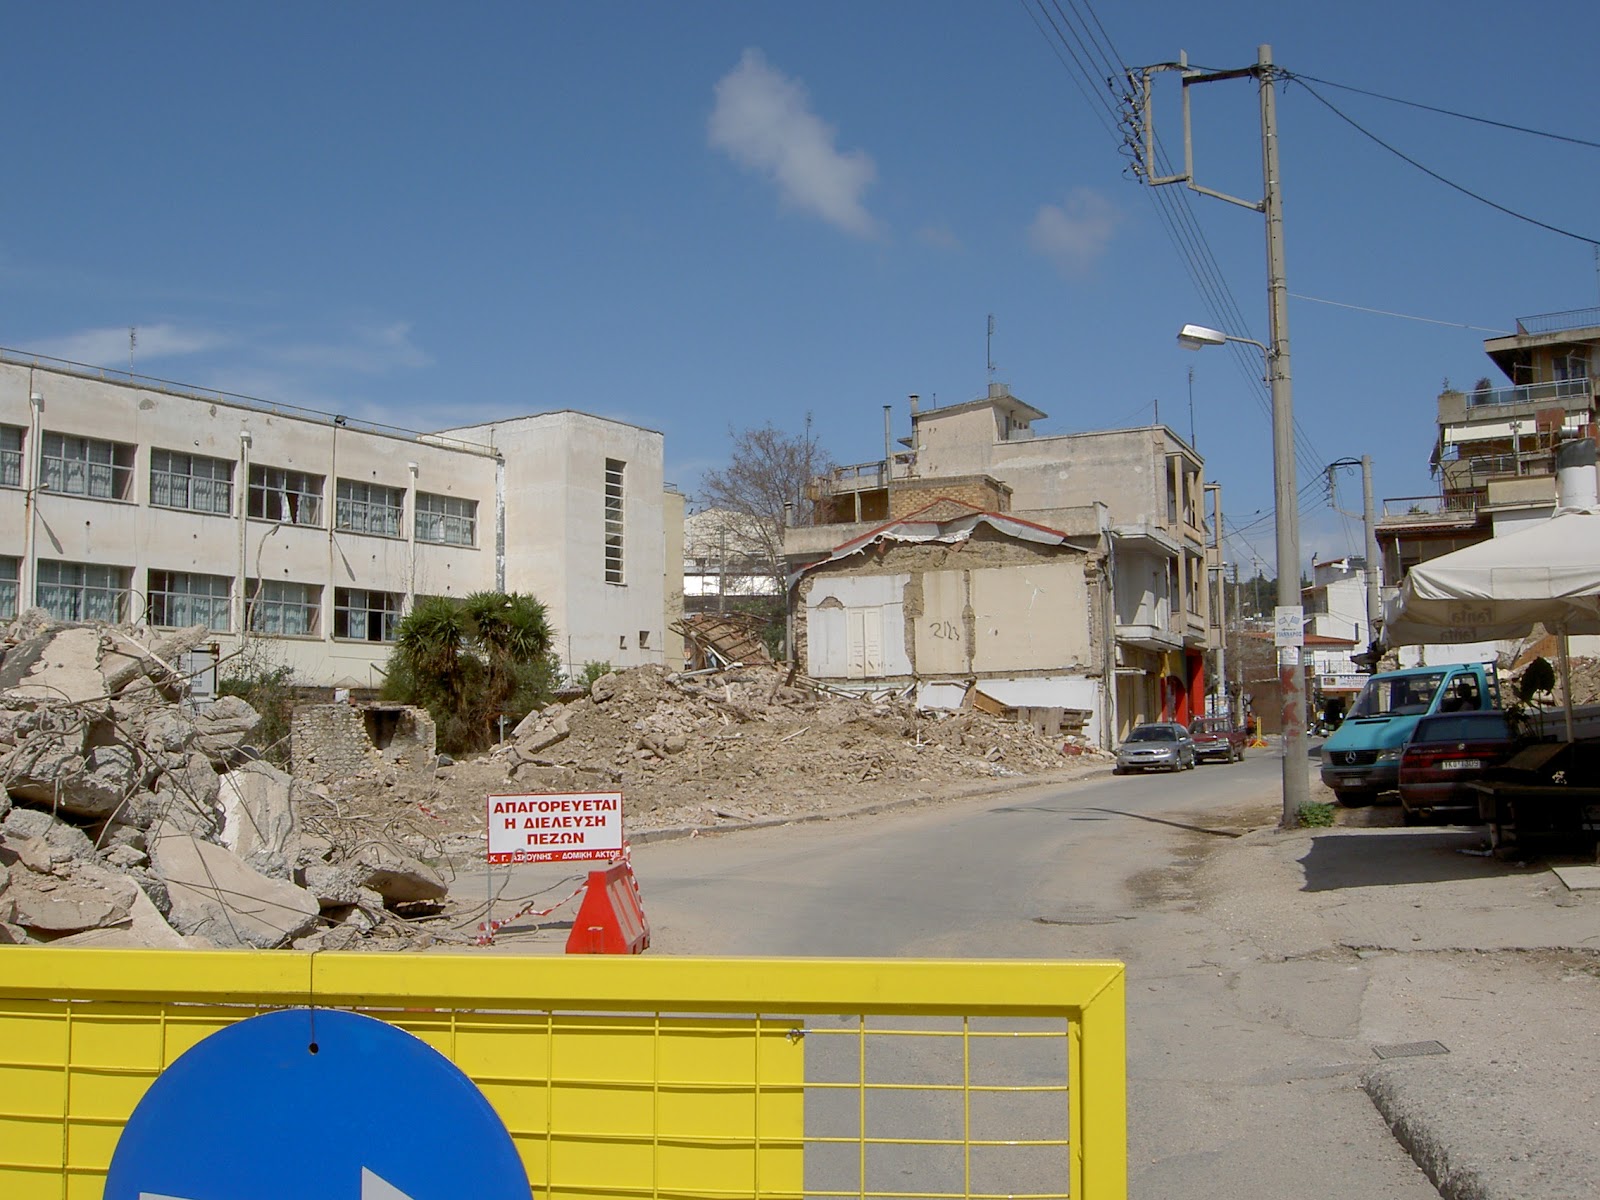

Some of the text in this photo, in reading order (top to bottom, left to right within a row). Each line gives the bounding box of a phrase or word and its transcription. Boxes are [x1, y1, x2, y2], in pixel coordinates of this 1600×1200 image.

[494, 799, 617, 815] ΑΠΑΓΟΡΕΥΕΤΑΙ
[505, 815, 606, 829] Η ΔΙΕΛΕΥΣΗ
[527, 832, 585, 844] ΠΕΖΩΝ
[562, 851, 593, 860] ΔΟΜΙΚΗ
